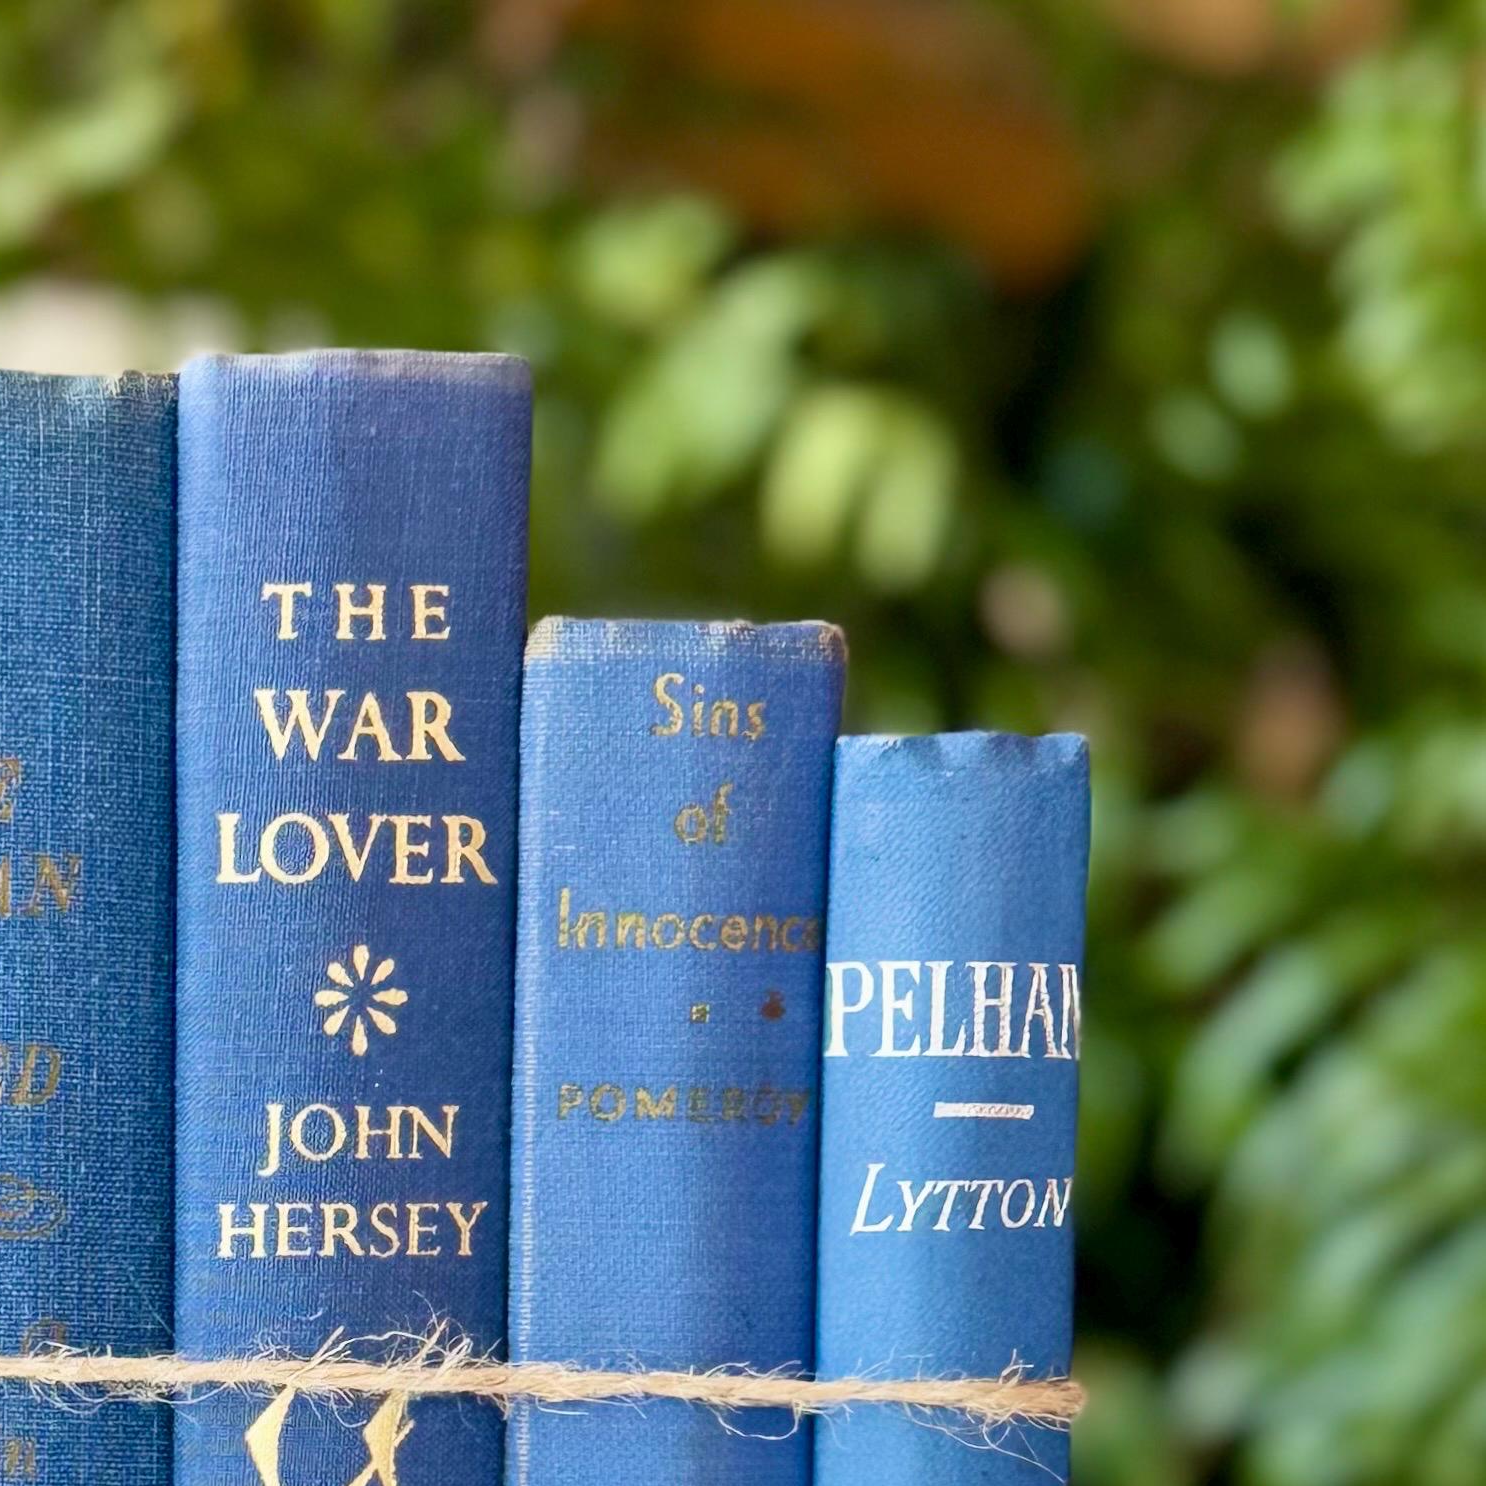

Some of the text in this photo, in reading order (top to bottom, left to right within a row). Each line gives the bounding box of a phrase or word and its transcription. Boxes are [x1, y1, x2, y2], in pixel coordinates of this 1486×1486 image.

[261, 582, 452, 641] THE
[252, 688, 467, 762] WAR
[650, 672, 767, 742] Sins
[216, 812, 499, 885] LOVER
[674, 780, 735, 847] of
[257, 1102, 460, 1176] JOHN
[216, 1200, 489, 1259] HERSEY
[849, 1162, 1074, 1237] LYTTON
